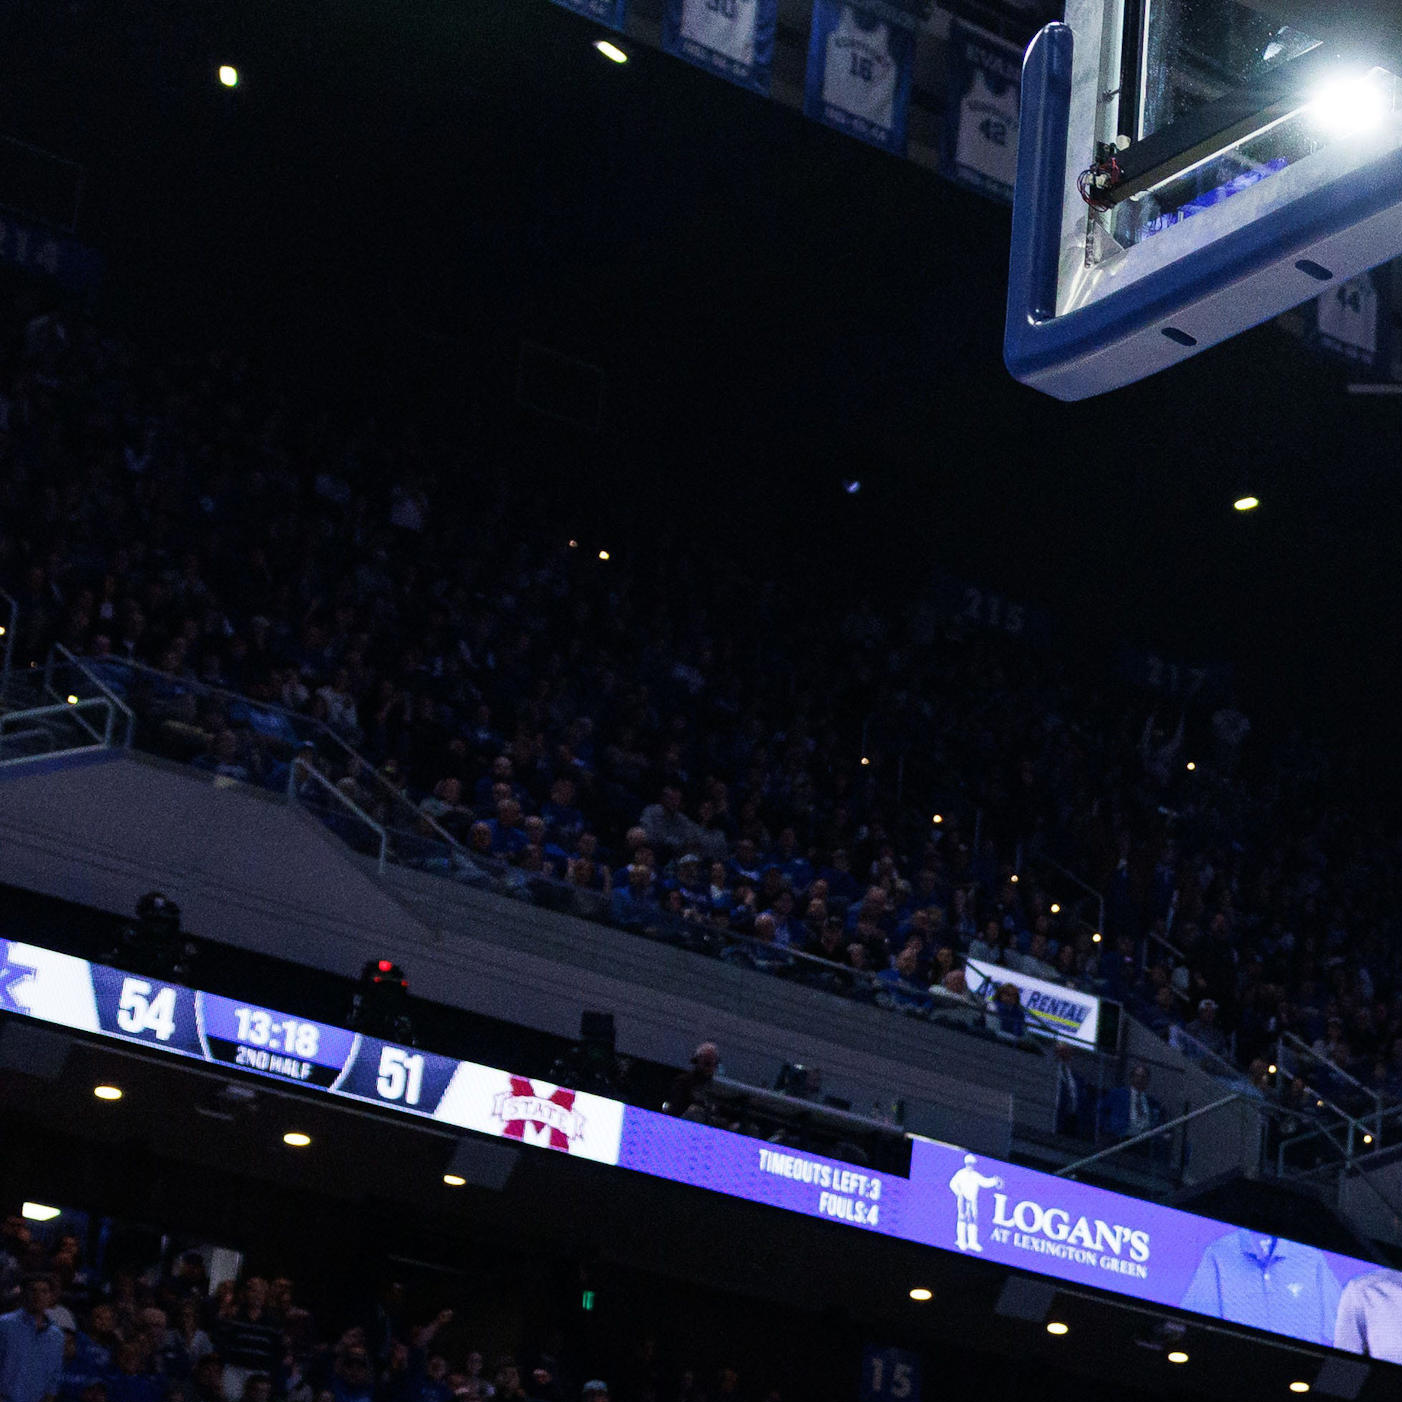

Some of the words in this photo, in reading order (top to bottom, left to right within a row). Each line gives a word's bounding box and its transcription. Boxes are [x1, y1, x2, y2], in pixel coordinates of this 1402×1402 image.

[116, 977, 177, 1041] 54
[234, 1006, 320, 1058] 13:18
[376, 1046, 425, 1105] 51
[759, 1148, 832, 1189] TIMEOUTS
[833, 1167, 882, 1201] LEFT:3
[819, 1190, 880, 1228] FOULS:4
[992, 1192, 1151, 1263] LOGAN'S
[1013, 1231, 1097, 1265] LEXINGTON
[1099, 1249, 1148, 1280] GREEN
